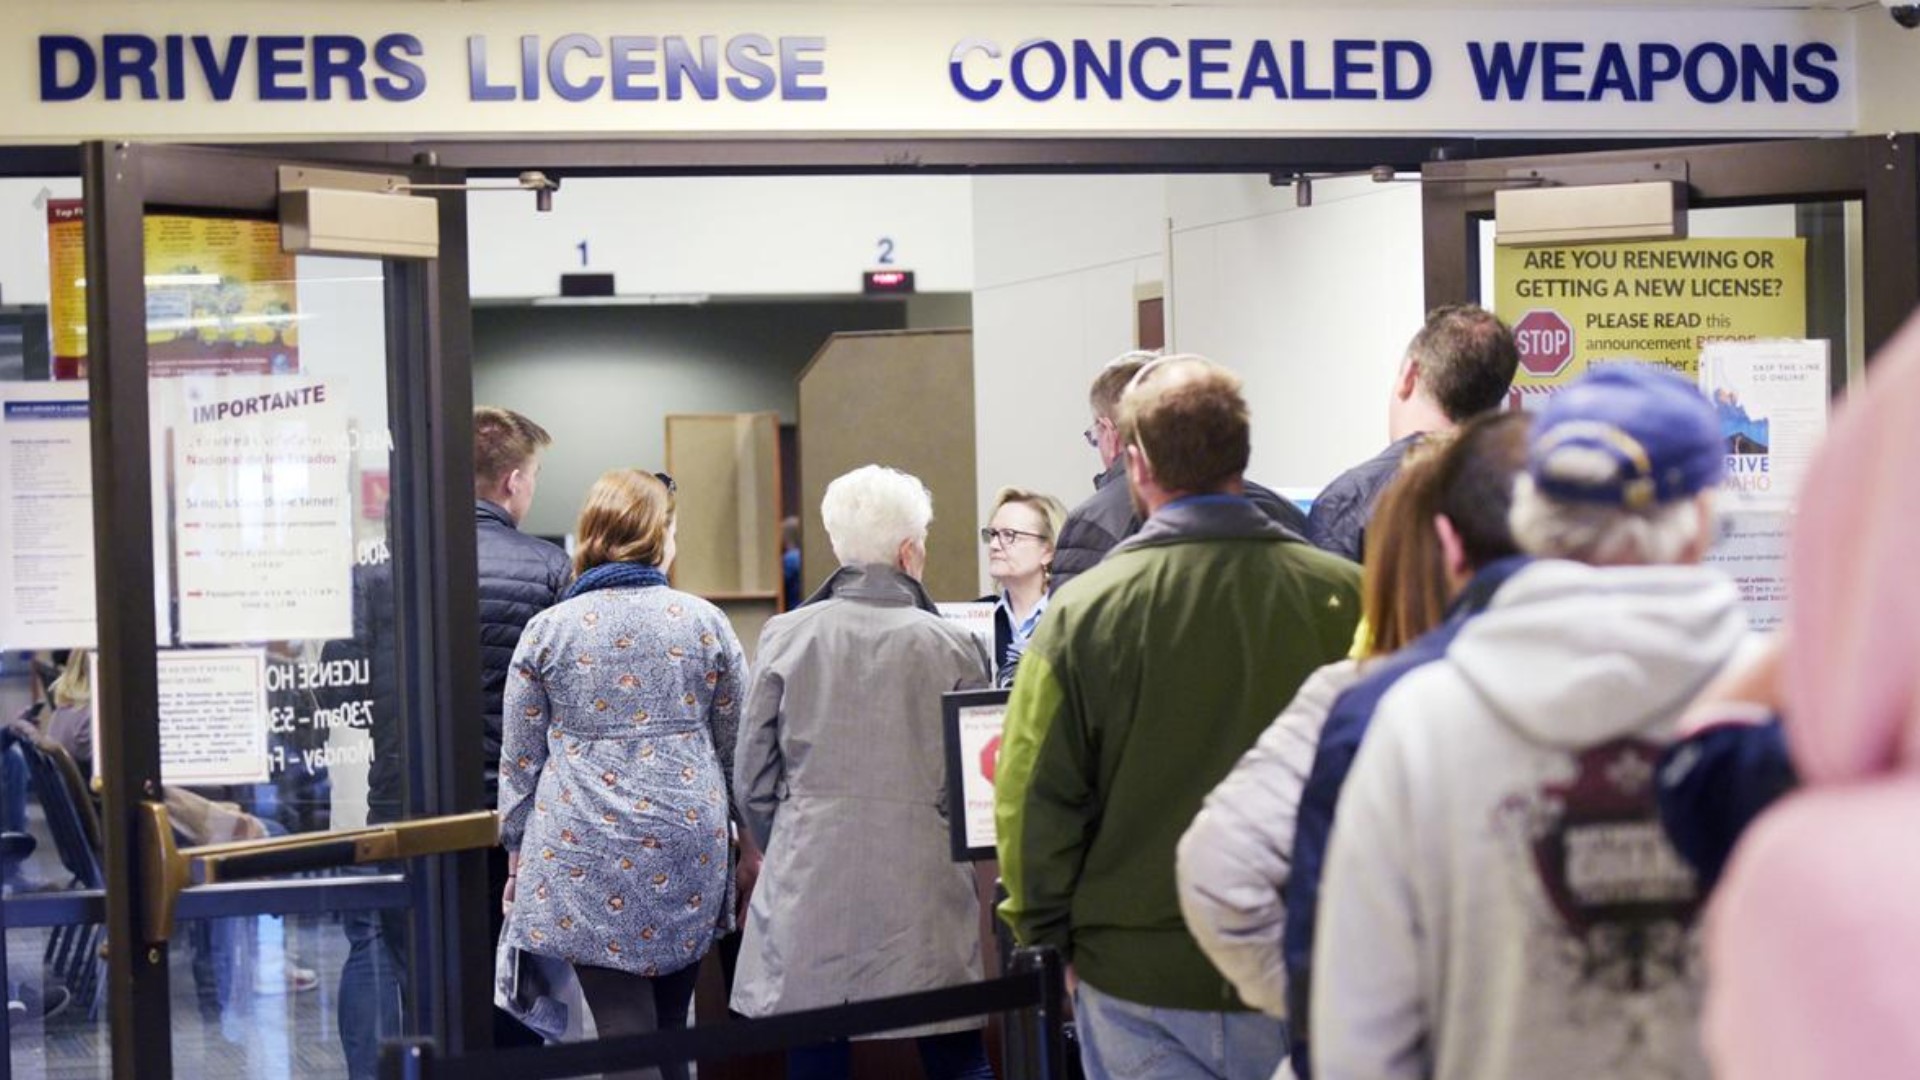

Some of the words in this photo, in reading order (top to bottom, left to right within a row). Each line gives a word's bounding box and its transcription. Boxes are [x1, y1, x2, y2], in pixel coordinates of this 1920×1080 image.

[40, 34, 426, 102] DRIVERS
[467, 35, 828, 102] LICENSE
[949, 37, 1432, 102] CONCEALED
[1466, 41, 1841, 105] WEAPONS
[577, 240, 588, 266] 1
[877, 238, 895, 264] 2
[1524, 250, 1565, 268] ARE
[1571, 250, 1617, 269] YOU
[1623, 249, 1738, 269] RENEWING
[1743, 250, 1775, 268] OR
[1515, 278, 1609, 298] GETTING
[1613, 279, 1629, 297] A
[1635, 278, 1686, 297] NEW
[1691, 277, 1783, 297] LICENSE?
[1586, 313, 1649, 329] PLEASE
[1654, 313, 1702, 329] READ
[1706, 313, 1731, 329] this
[1517, 329, 1566, 355] STOP
[1586, 337, 1691, 351] announcement
[192, 384, 326, 424] IMPORTANTE
[1726, 456, 1771, 473] RIVE
[1727, 474, 1771, 492] AHO
